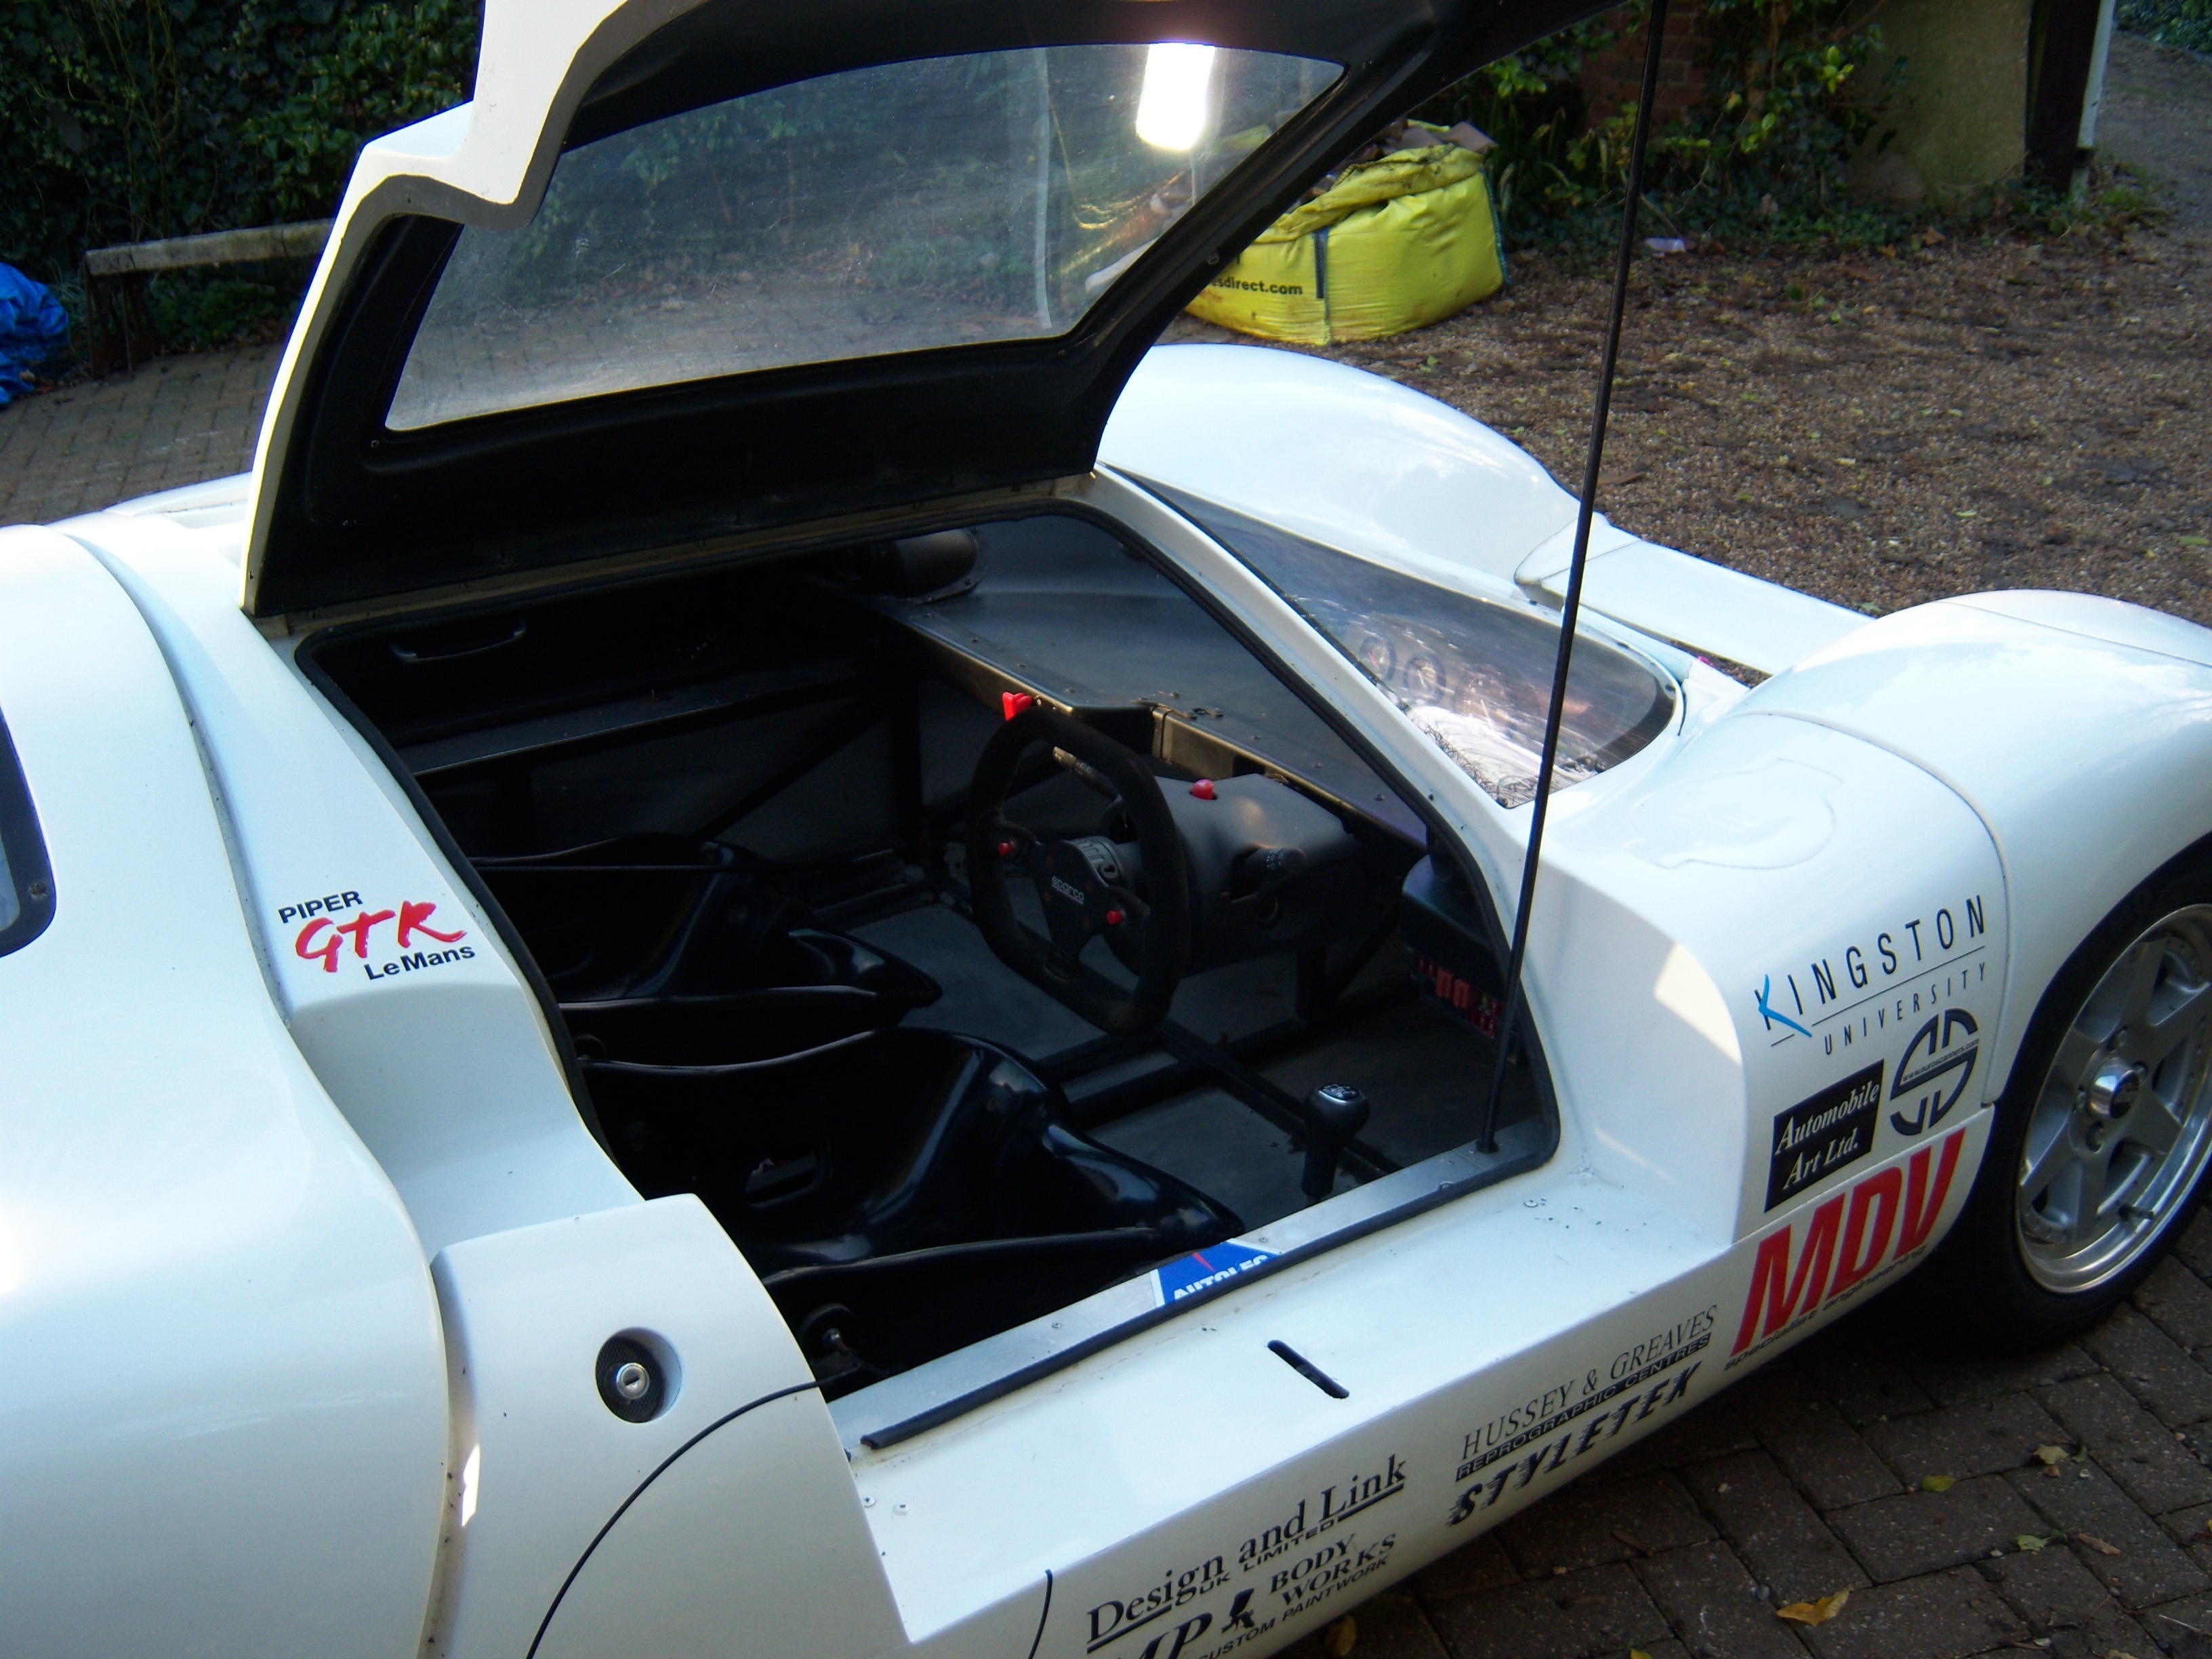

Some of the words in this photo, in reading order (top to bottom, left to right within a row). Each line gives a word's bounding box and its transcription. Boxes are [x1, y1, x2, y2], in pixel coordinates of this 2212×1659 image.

[278, 890, 363, 924] PIPER
[1052, 876, 1084, 901] sparco
[295, 900, 468, 973] GTR
[1754, 895, 1985, 1038] KINGSTON
[1824, 962, 1986, 1055] UNIVERSITY
[1774, 1080, 1880, 1155] Automobile
[1782, 1151, 1821, 1190] Art
[1823, 1126, 1859, 1166] Ltd.
[1729, 1128, 1965, 1358] MDV
[1458, 1387, 1618, 1479] REPROGRAPHIC
[1625, 1332, 1712, 1388] CENTRES
[1461, 1379, 1575, 1460] HUSSEY
[1582, 1368, 1598, 1396] &
[1610, 1304, 1717, 1380] GREAVES
[1086, 1555, 1224, 1644] Design
[1238, 1499, 1306, 1563] and
[1319, 1454, 1406, 1522] Link
[1243, 1519, 1335, 1572] LIMITED
[1269, 1532, 1356, 1594] BODY
[1282, 1532, 1396, 1605] WORKS
[1282, 1557, 1389, 1622] PAINTWORK
